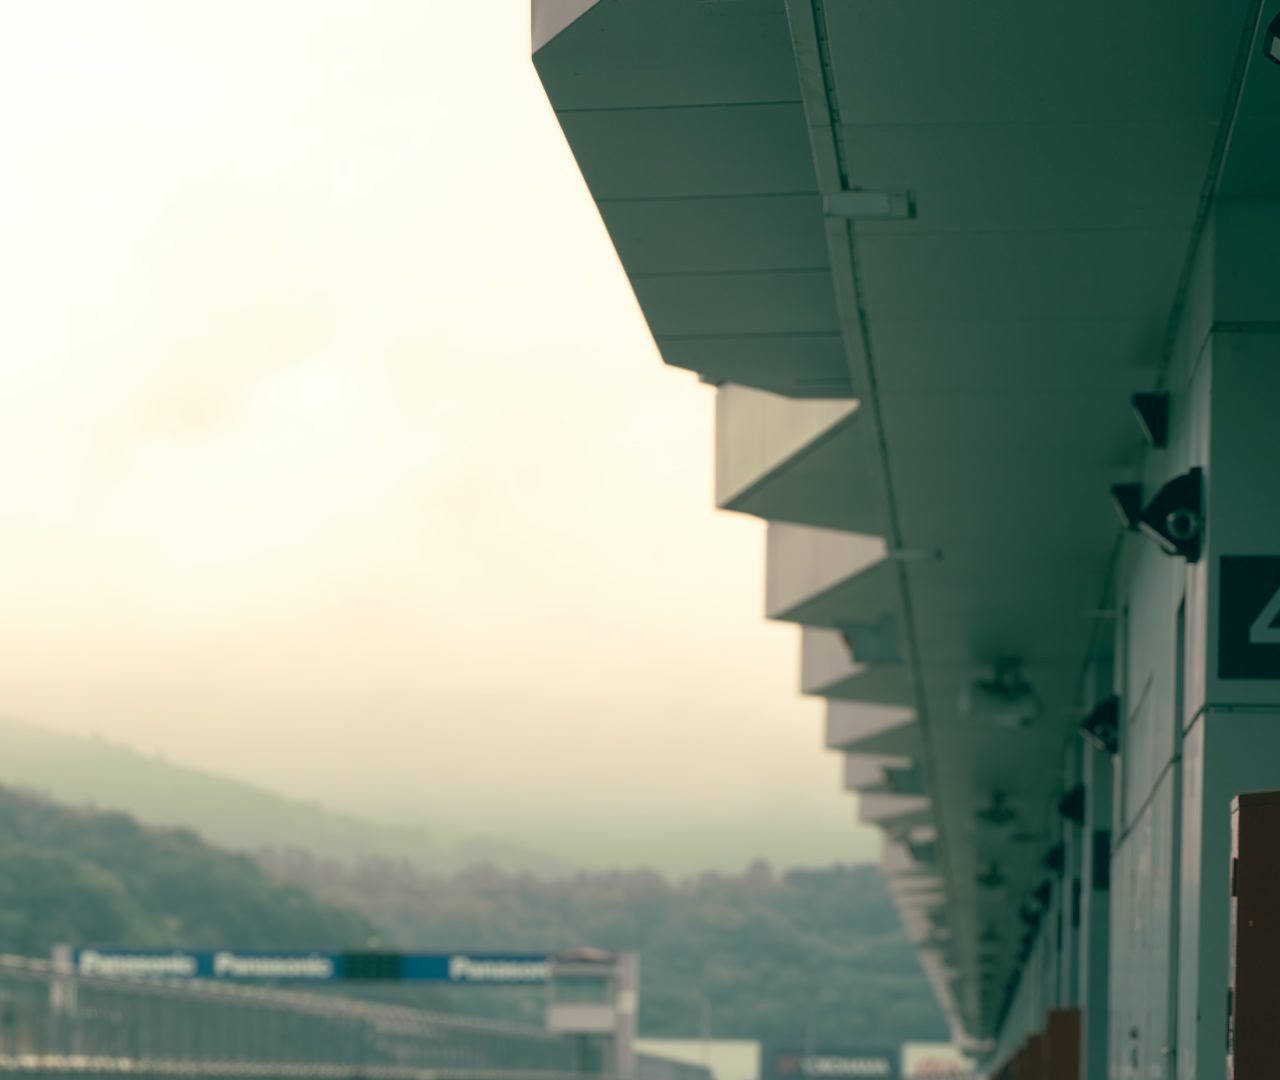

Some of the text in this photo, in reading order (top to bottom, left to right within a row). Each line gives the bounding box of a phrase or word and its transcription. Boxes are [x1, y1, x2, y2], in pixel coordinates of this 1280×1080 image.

[79, 951, 553, 980] Panasonic Panasonic Panason
